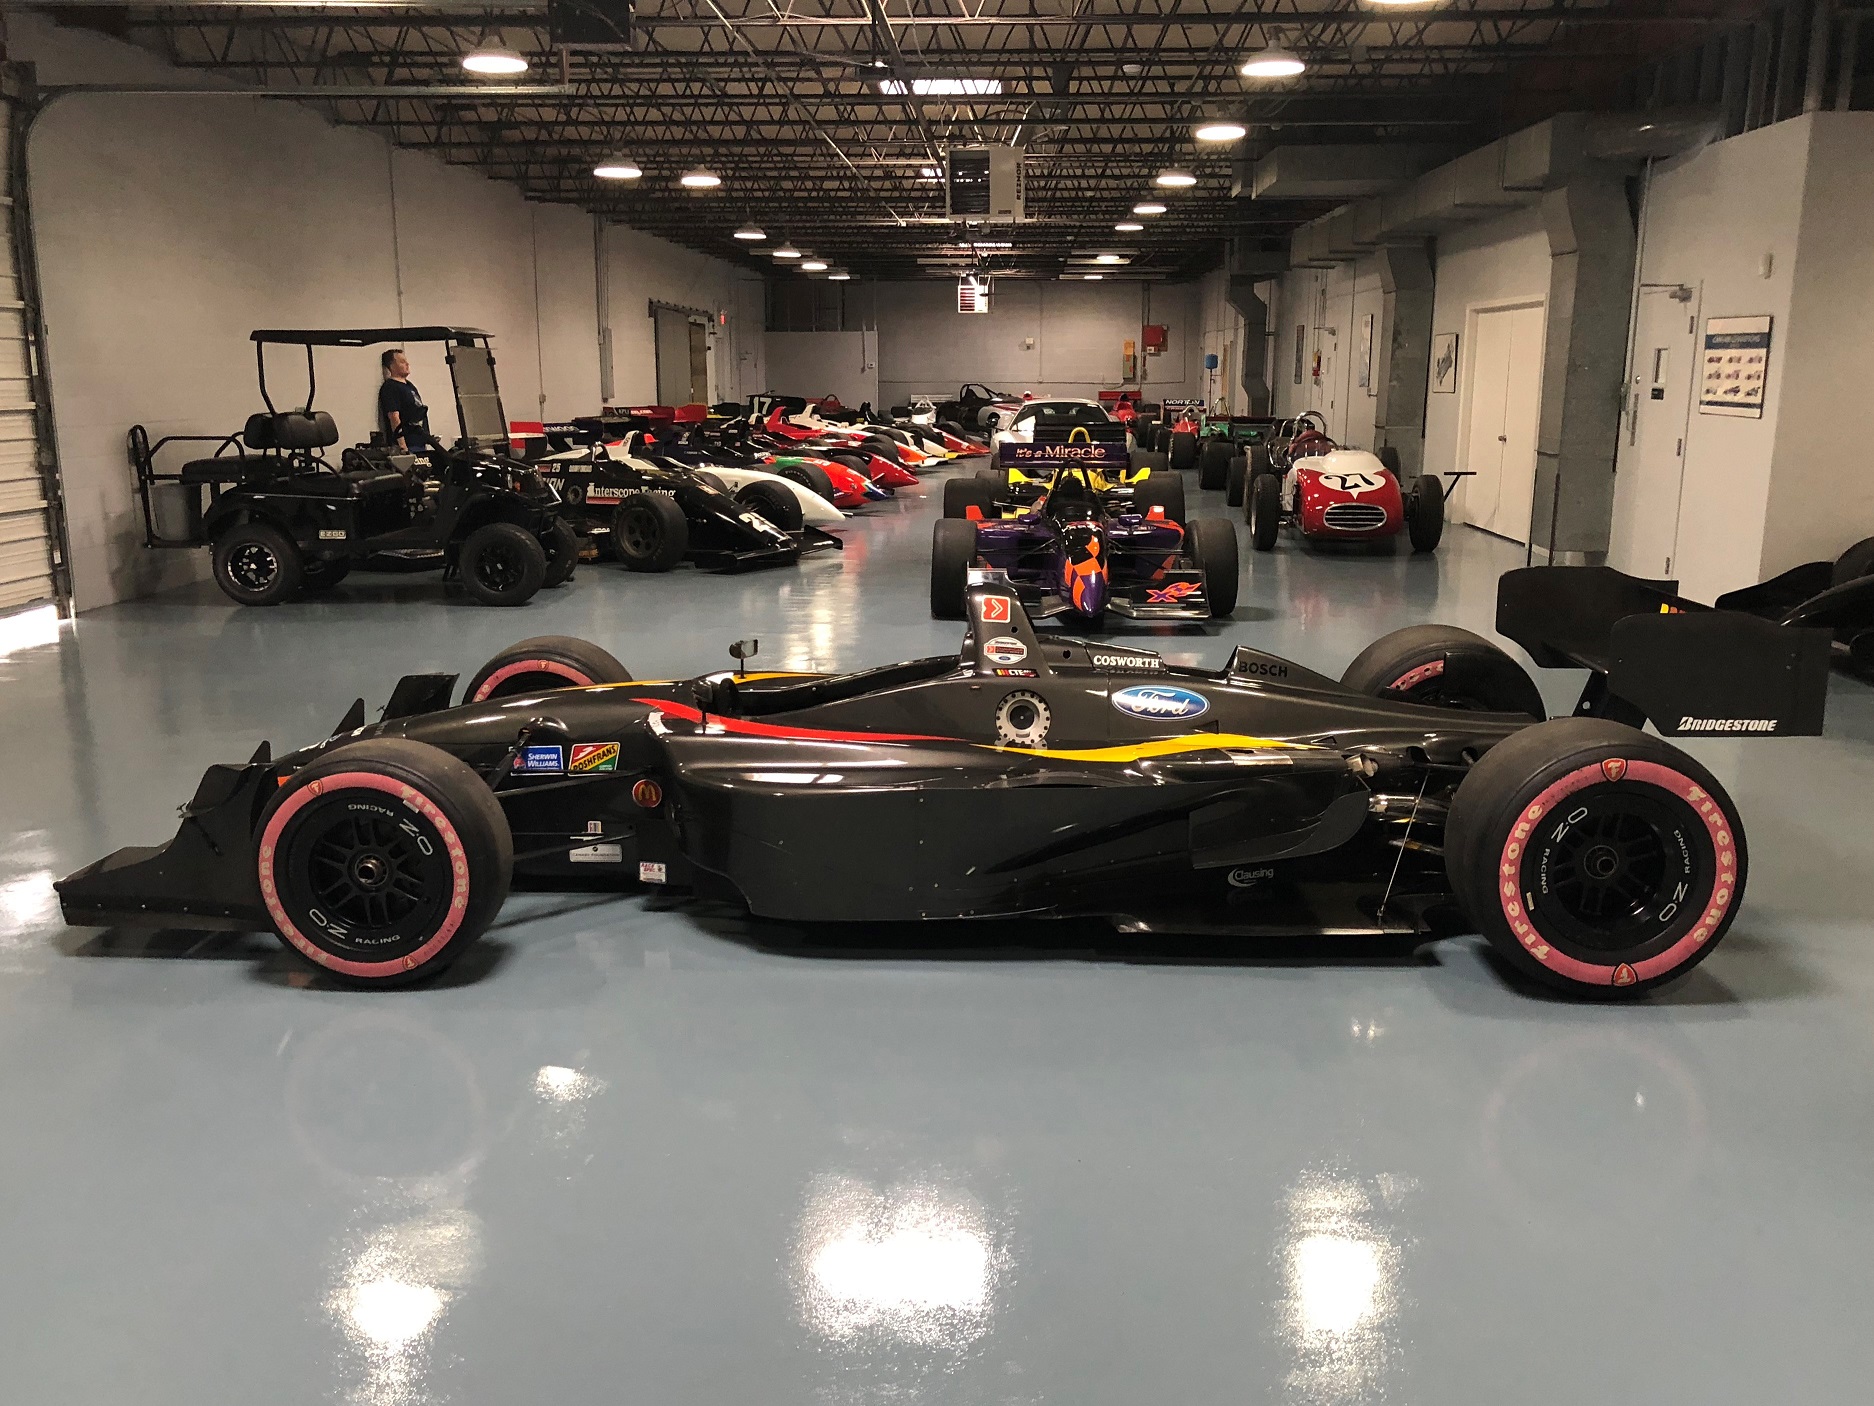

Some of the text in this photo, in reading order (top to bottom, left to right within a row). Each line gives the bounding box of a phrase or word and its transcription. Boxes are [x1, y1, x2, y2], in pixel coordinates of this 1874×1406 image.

[753, 396, 772, 415] 17
[1045, 445, 1106, 458] Miracle
[551, 463, 561, 473] 25
[586, 482, 640, 498] Interscope
[1323, 472, 1376, 491] 27
[1093, 655, 1161, 669] COSWORTH
[1238, 660, 1288, 678] BOSCH
[1128, 688, 1190, 716] Ford
[1677, 715, 1779, 731] BRIDGESTONE
[527, 752, 558, 761] SHERWIN
[347, 804, 394, 817] RACING
[401, 785, 467, 908] Firestone
[1673, 829, 1690, 874] RACING
[1541, 848, 1550, 894] RACING
[1687, 786, 1735, 942] Firestone
[1234, 868, 1275, 880] Clausing
[1502, 804, 1550, 960] Firestone
[261, 844, 328, 965] Firestone
[355, 934, 401, 945] RACING
